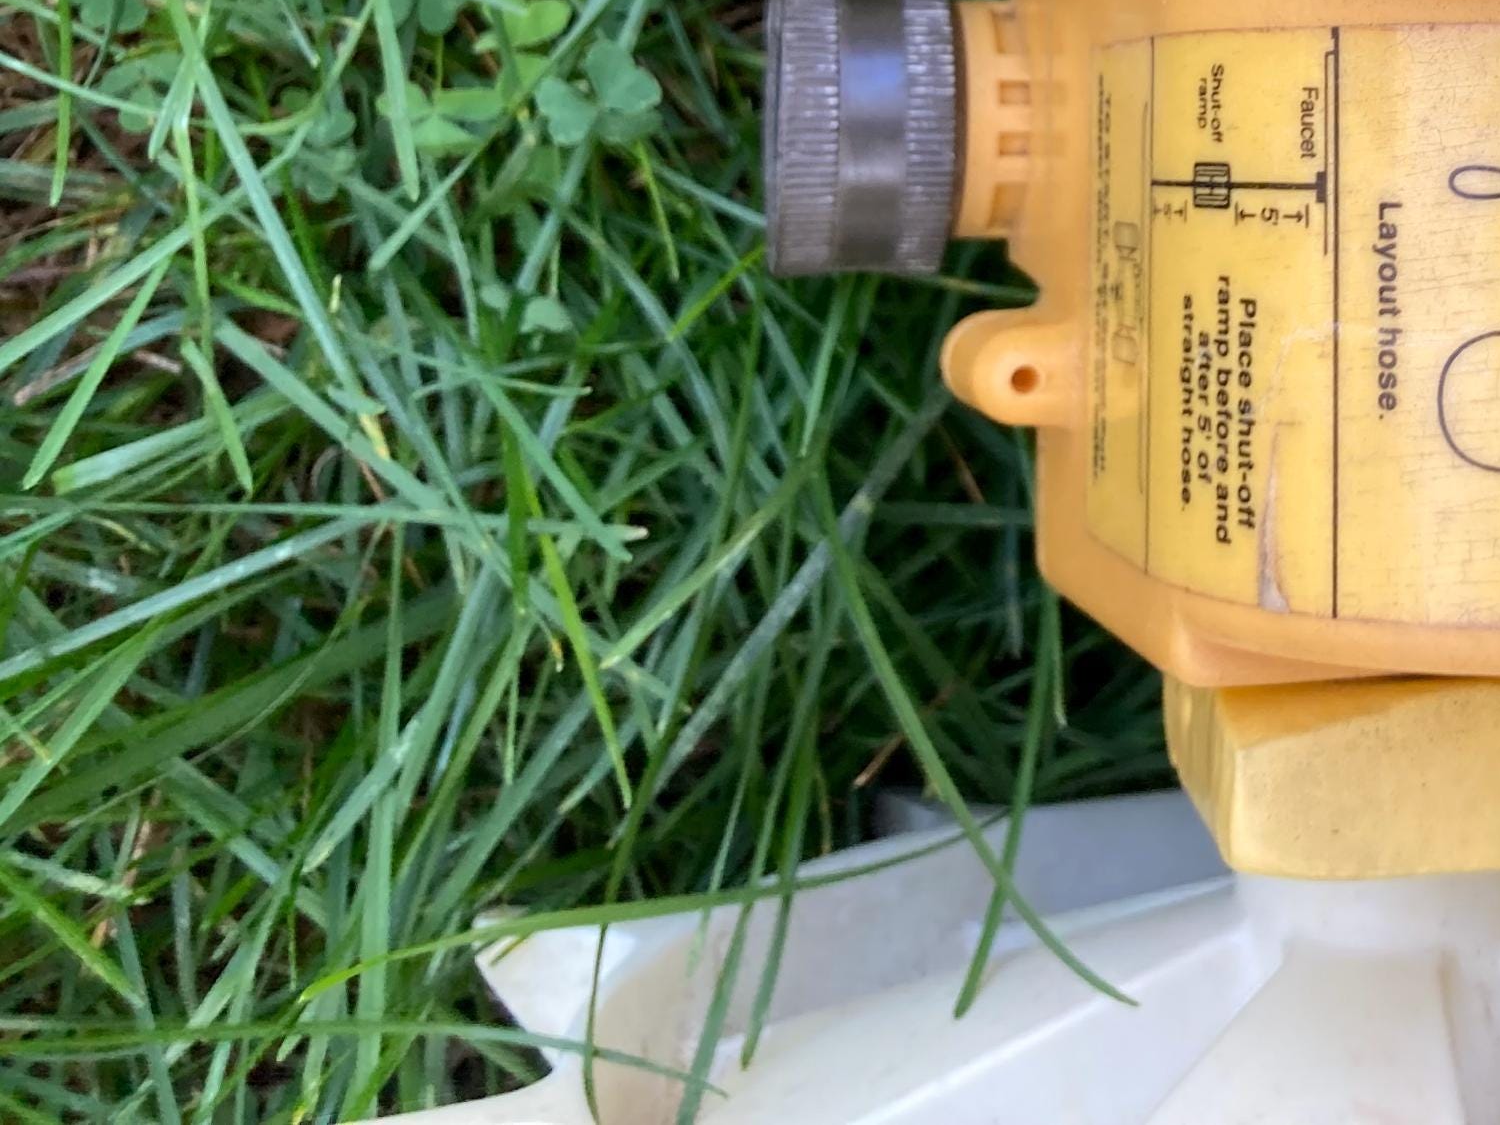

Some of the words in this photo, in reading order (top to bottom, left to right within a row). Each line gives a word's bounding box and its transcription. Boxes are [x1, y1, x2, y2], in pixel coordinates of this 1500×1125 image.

[1197, 77, 1208, 130] ramp
[1210, 63, 1225, 143] Shut-off
[1300, 87, 1319, 159] Faucet
[1373, 201, 1403, 317] Layout
[1179, 294, 1195, 417] straight
[1213, 275, 1231, 358] ramp
[1238, 297, 1257, 389] Place
[1197, 330, 1212, 406] after
[1377, 325, 1404, 421] hose.
[1216, 368, 1232, 474] before
[1237, 395, 1257, 531] shut-off
[1181, 426, 1194, 512] hose.
[1197, 451, 1212, 484] of
[1216, 483, 1232, 545] and
